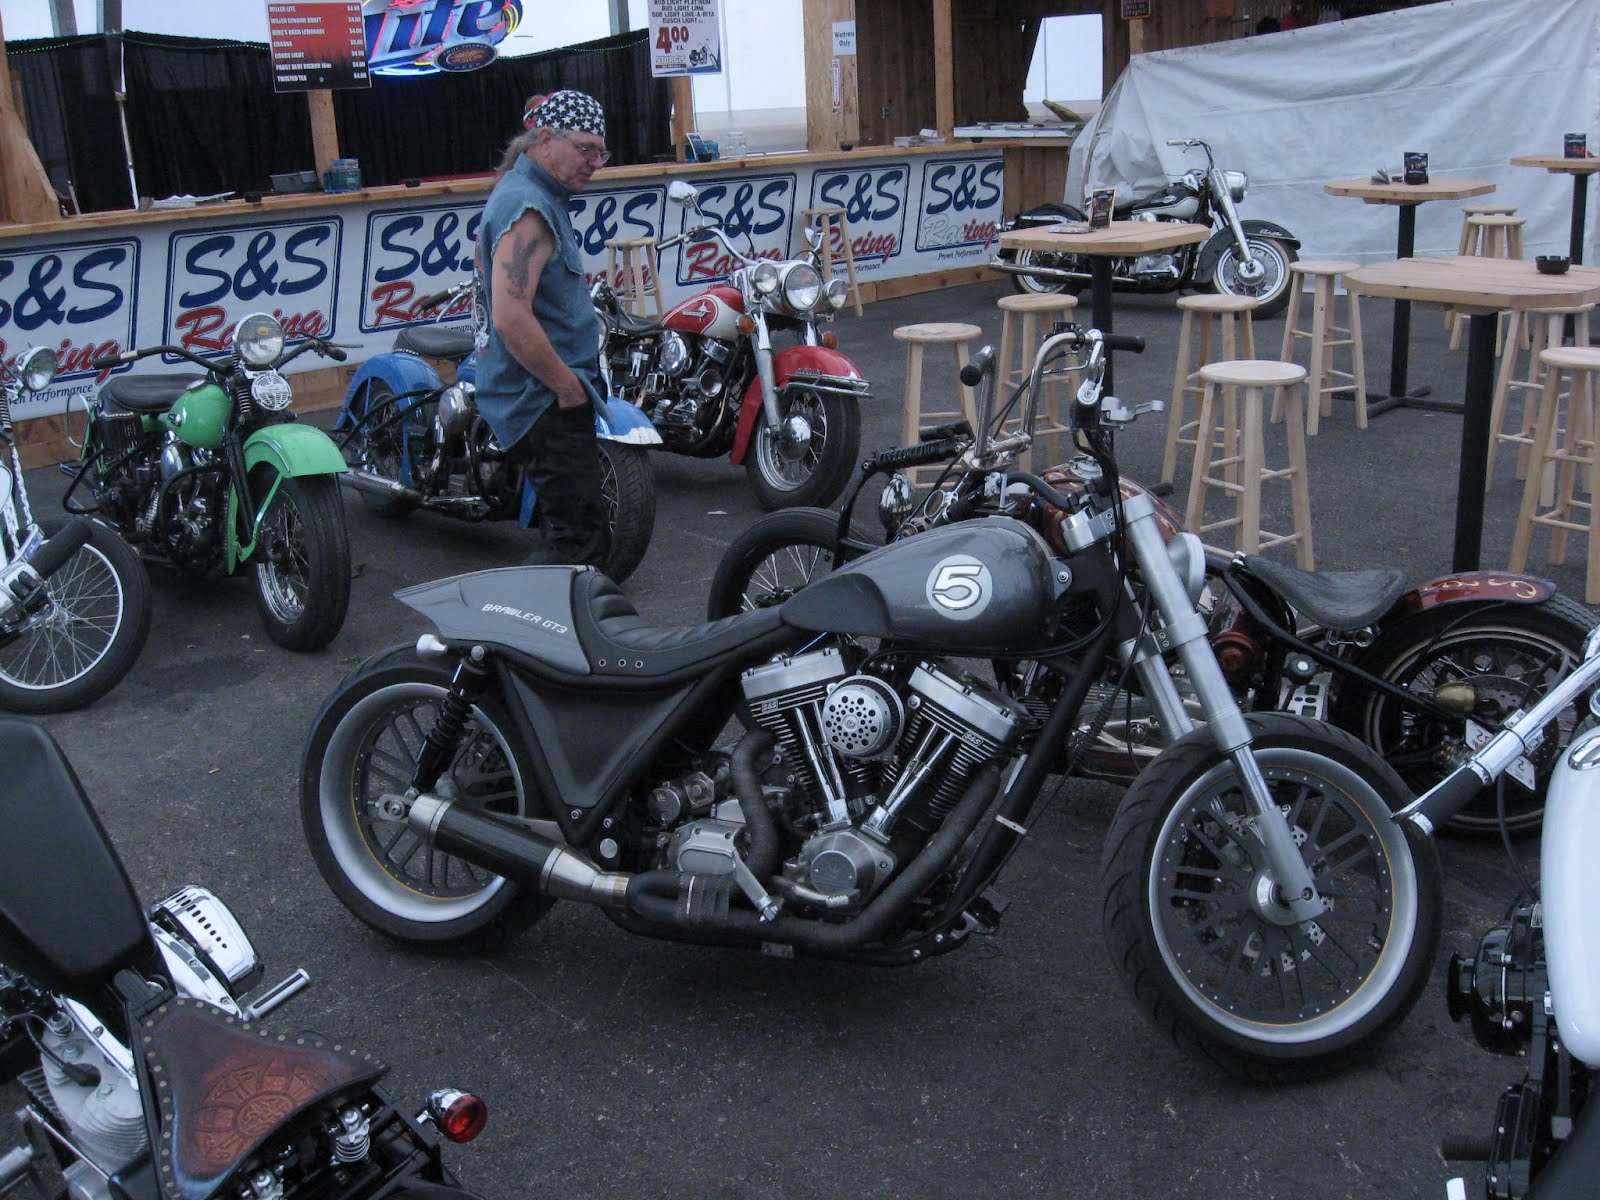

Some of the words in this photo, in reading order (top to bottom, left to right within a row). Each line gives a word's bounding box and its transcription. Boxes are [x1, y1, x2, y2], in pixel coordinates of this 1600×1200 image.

[816, 170, 904, 226] S&S
[926, 162, 1003, 214] S&S
[0, 248, 127, 331] &S
[179, 225, 331, 308] S&S
[29, 383, 94, 402] Performance
[931, 564, 983, 610] 5
[481, 604, 542, 624] BRAWLER
[542, 620, 568, 634] GT3
